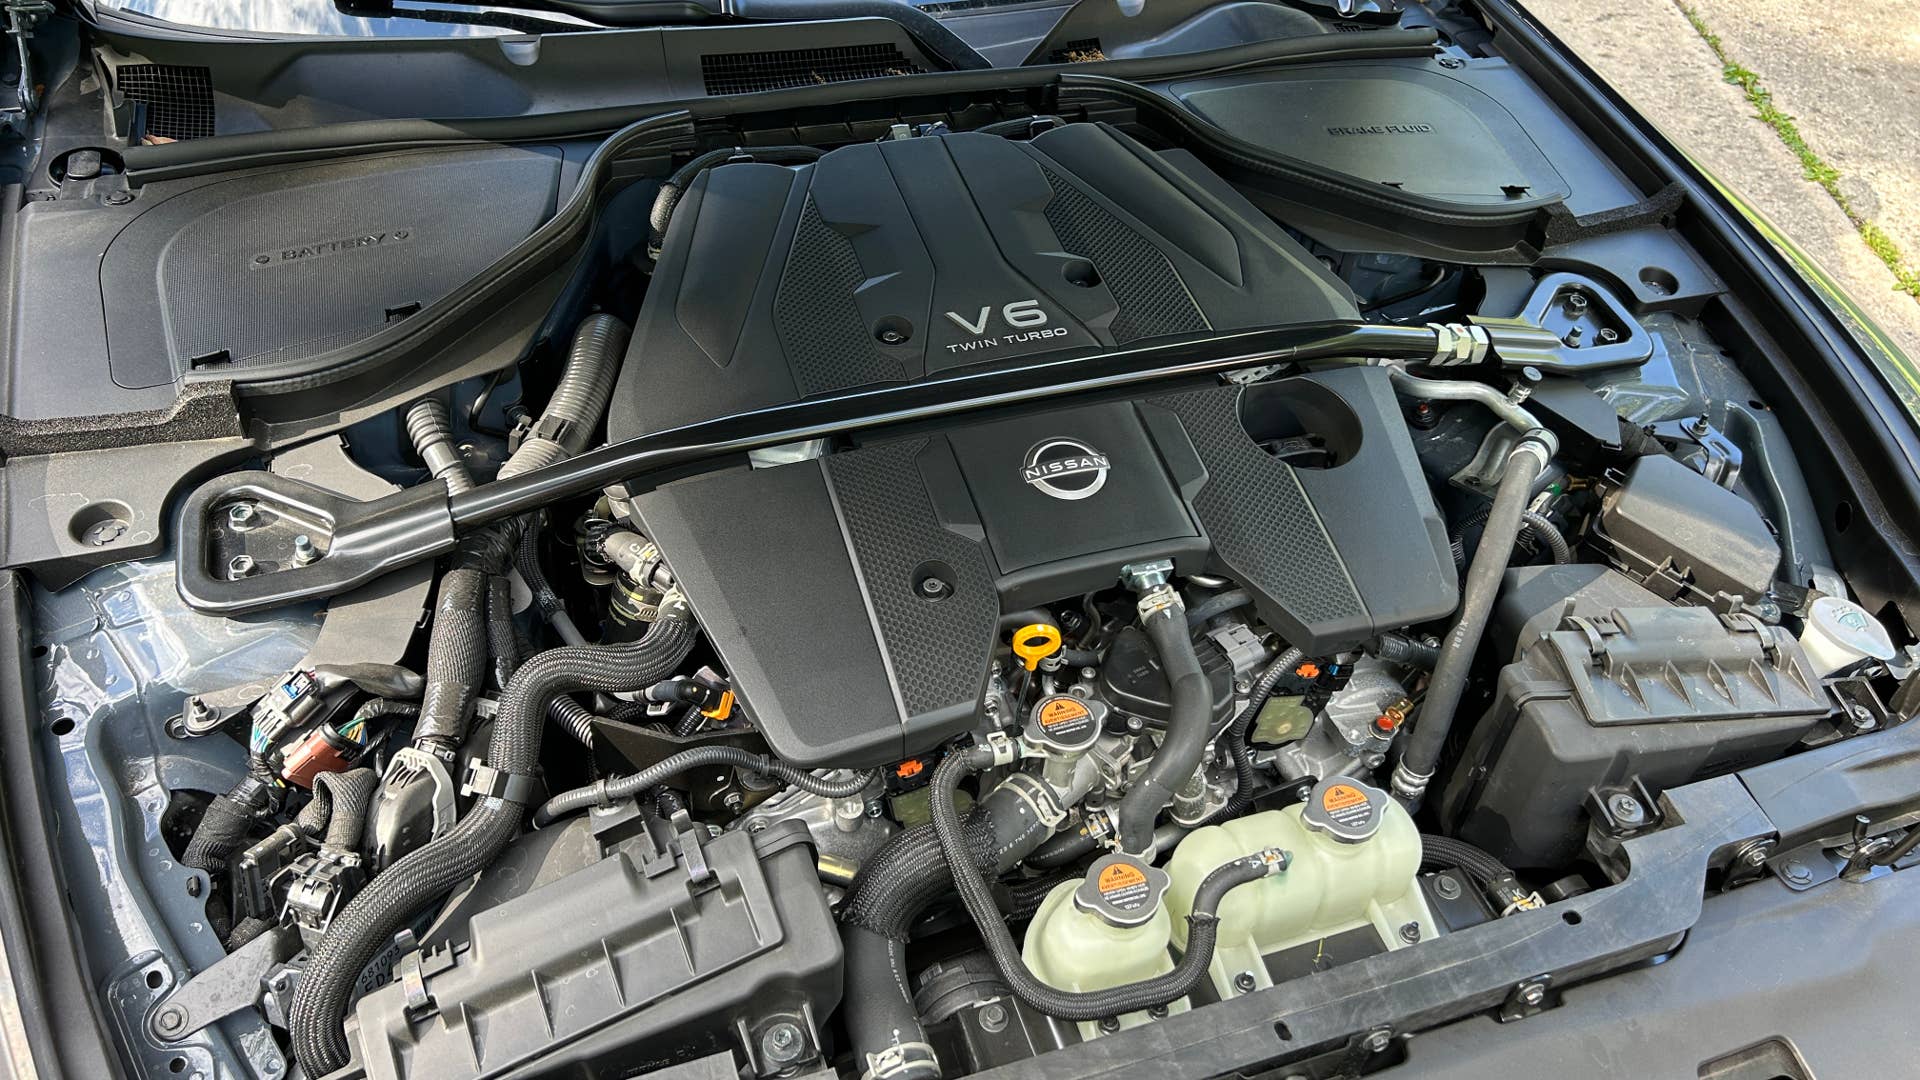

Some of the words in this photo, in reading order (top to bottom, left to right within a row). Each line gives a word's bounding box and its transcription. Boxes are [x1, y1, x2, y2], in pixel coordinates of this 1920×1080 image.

[1327, 126, 1384, 136] BRAKE
[1385, 124, 1432, 134] FLUID
[282, 233, 386, 260] BATTERY
[946, 338, 998, 353] TWIN
[1003, 327, 1068, 344] TURBO
[1025, 457, 1108, 480] NISSAN
[361, 945, 401, 984] 681093
